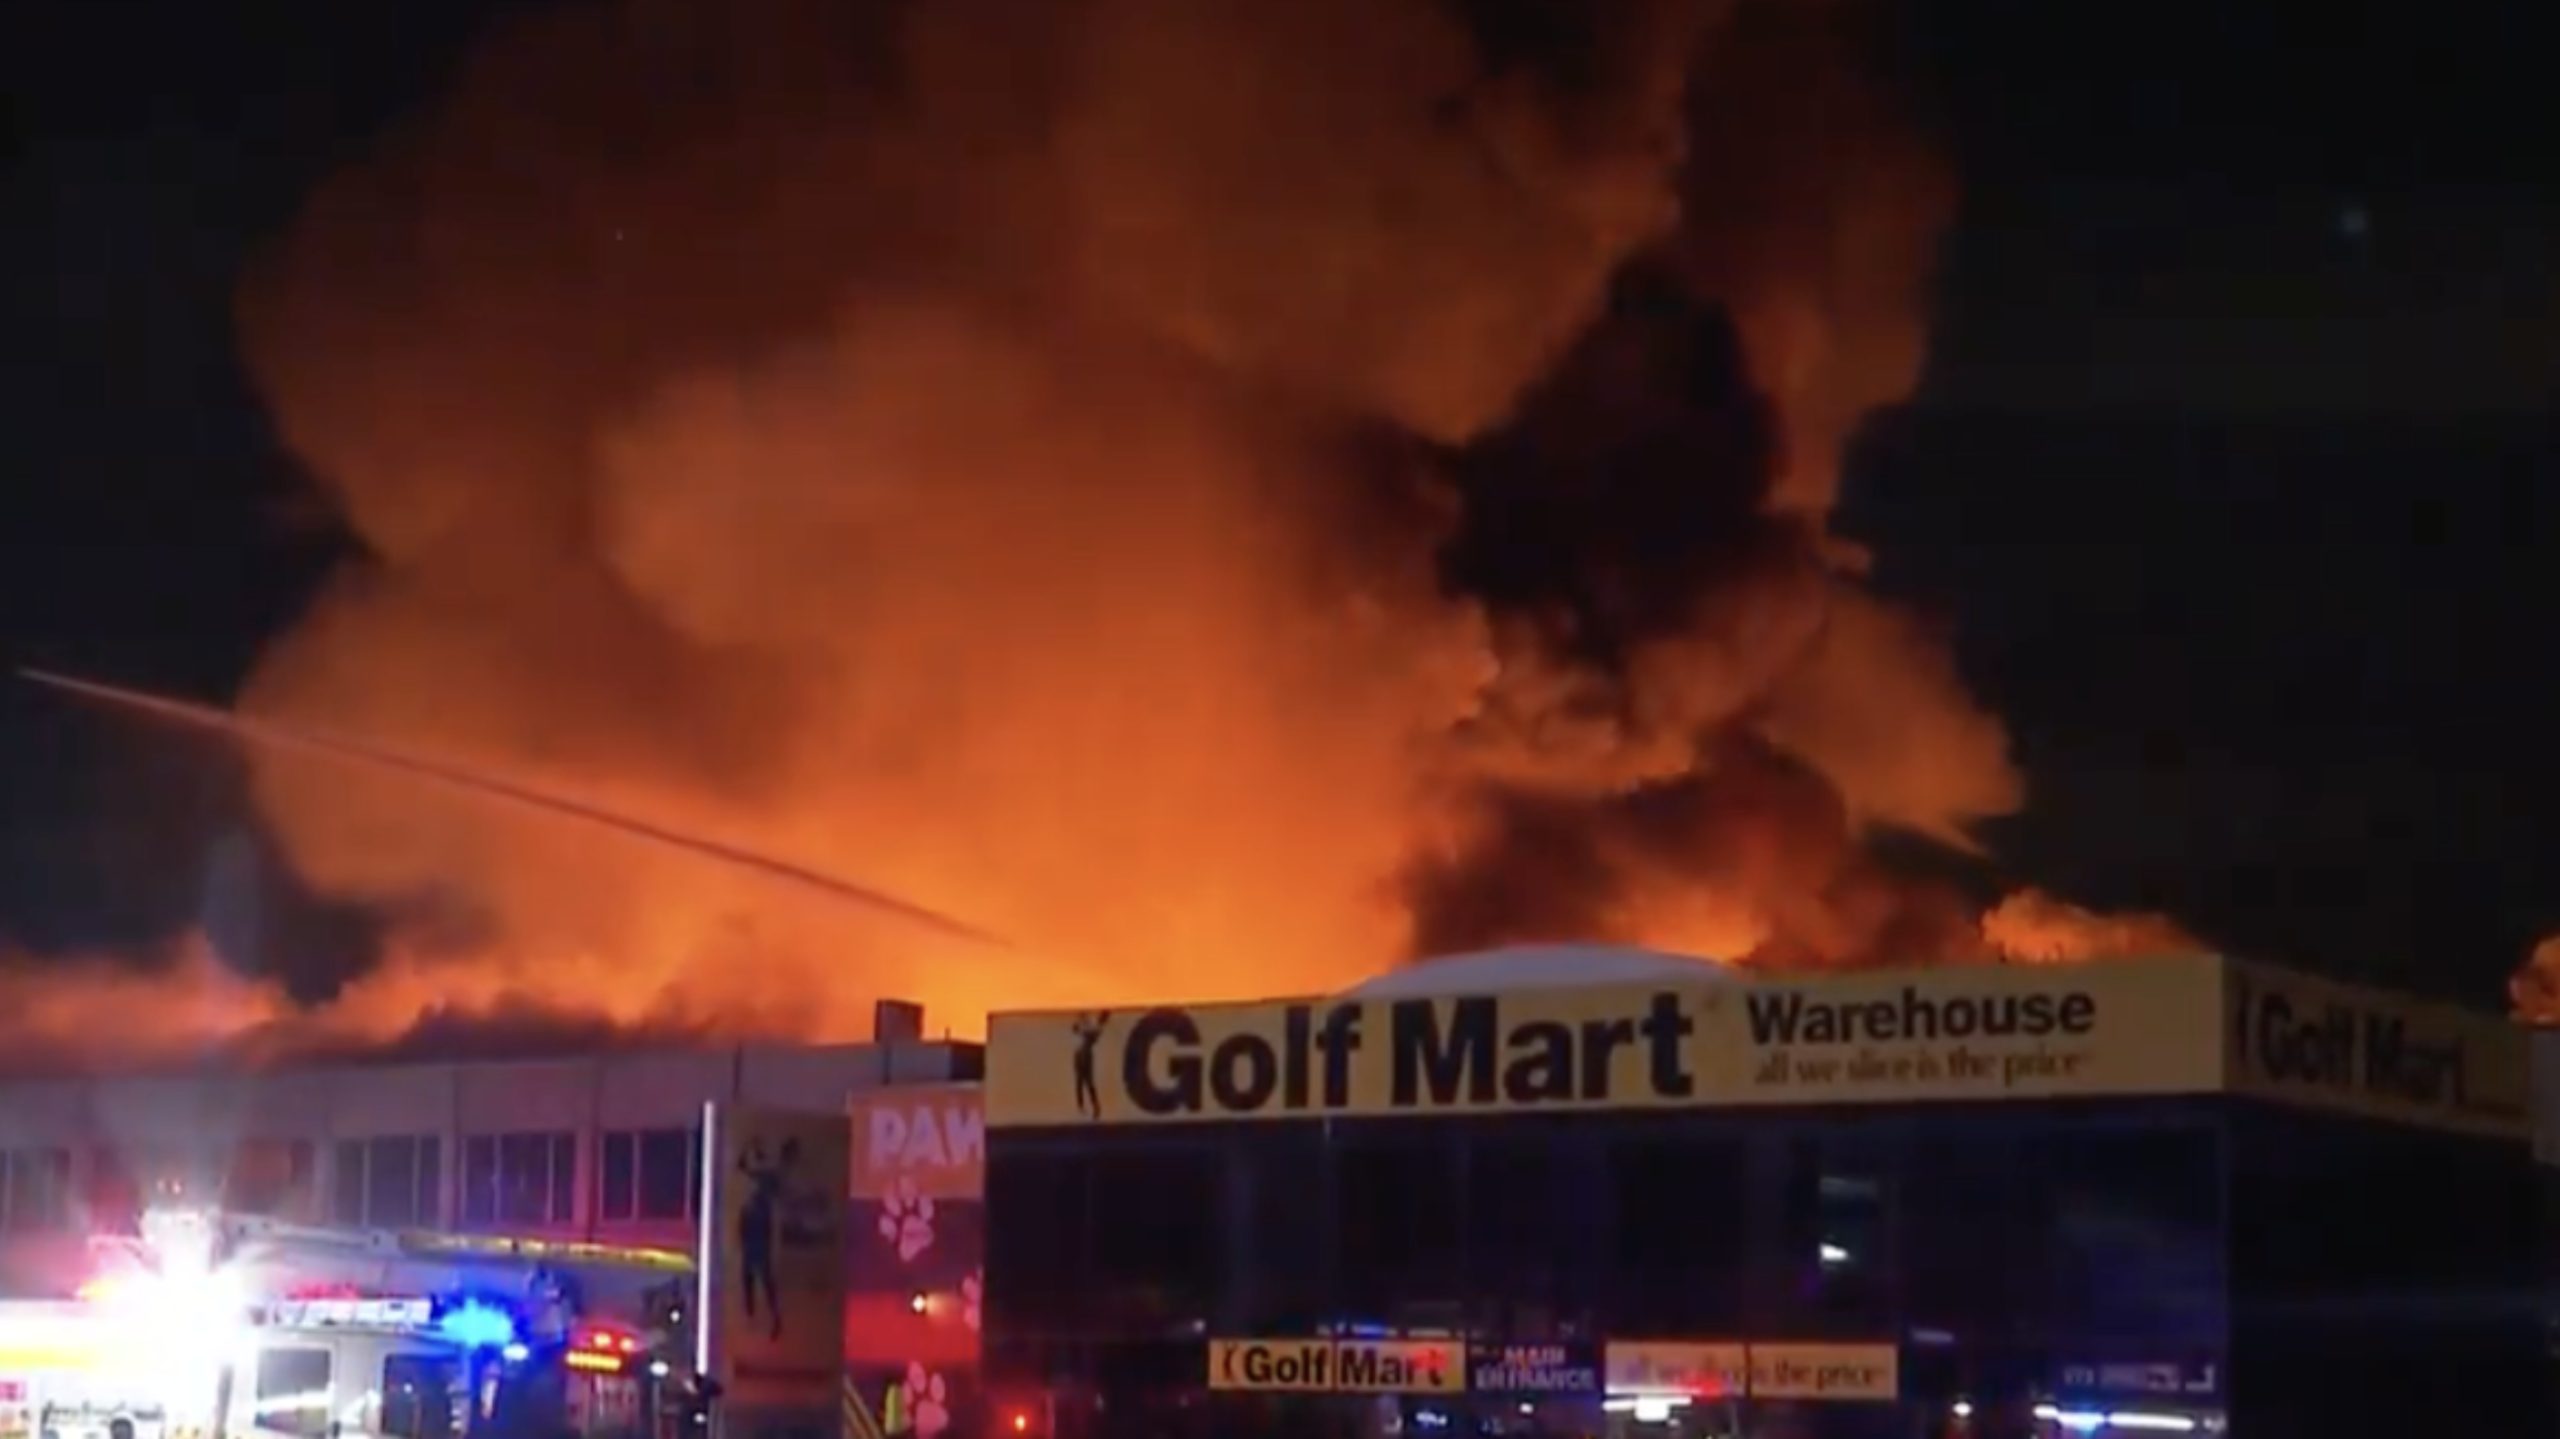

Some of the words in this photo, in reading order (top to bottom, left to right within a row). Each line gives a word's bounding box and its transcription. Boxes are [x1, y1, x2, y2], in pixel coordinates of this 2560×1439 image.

[1746, 986, 2096, 1045] Warehouse
[1121, 1003, 1361, 1114] Golf
[1390, 993, 1693, 1110] Mart
[2262, 993, 2354, 1086] Golf
[1754, 1051, 1788, 1085] all
[1948, 1045, 1997, 1079] the
[1243, 1346, 1328, 1385] Golf
[1340, 1346, 1443, 1387] Mart
[1504, 1346, 1565, 1365] MAIN
[1475, 1366, 1594, 1390] ENTRANCE
